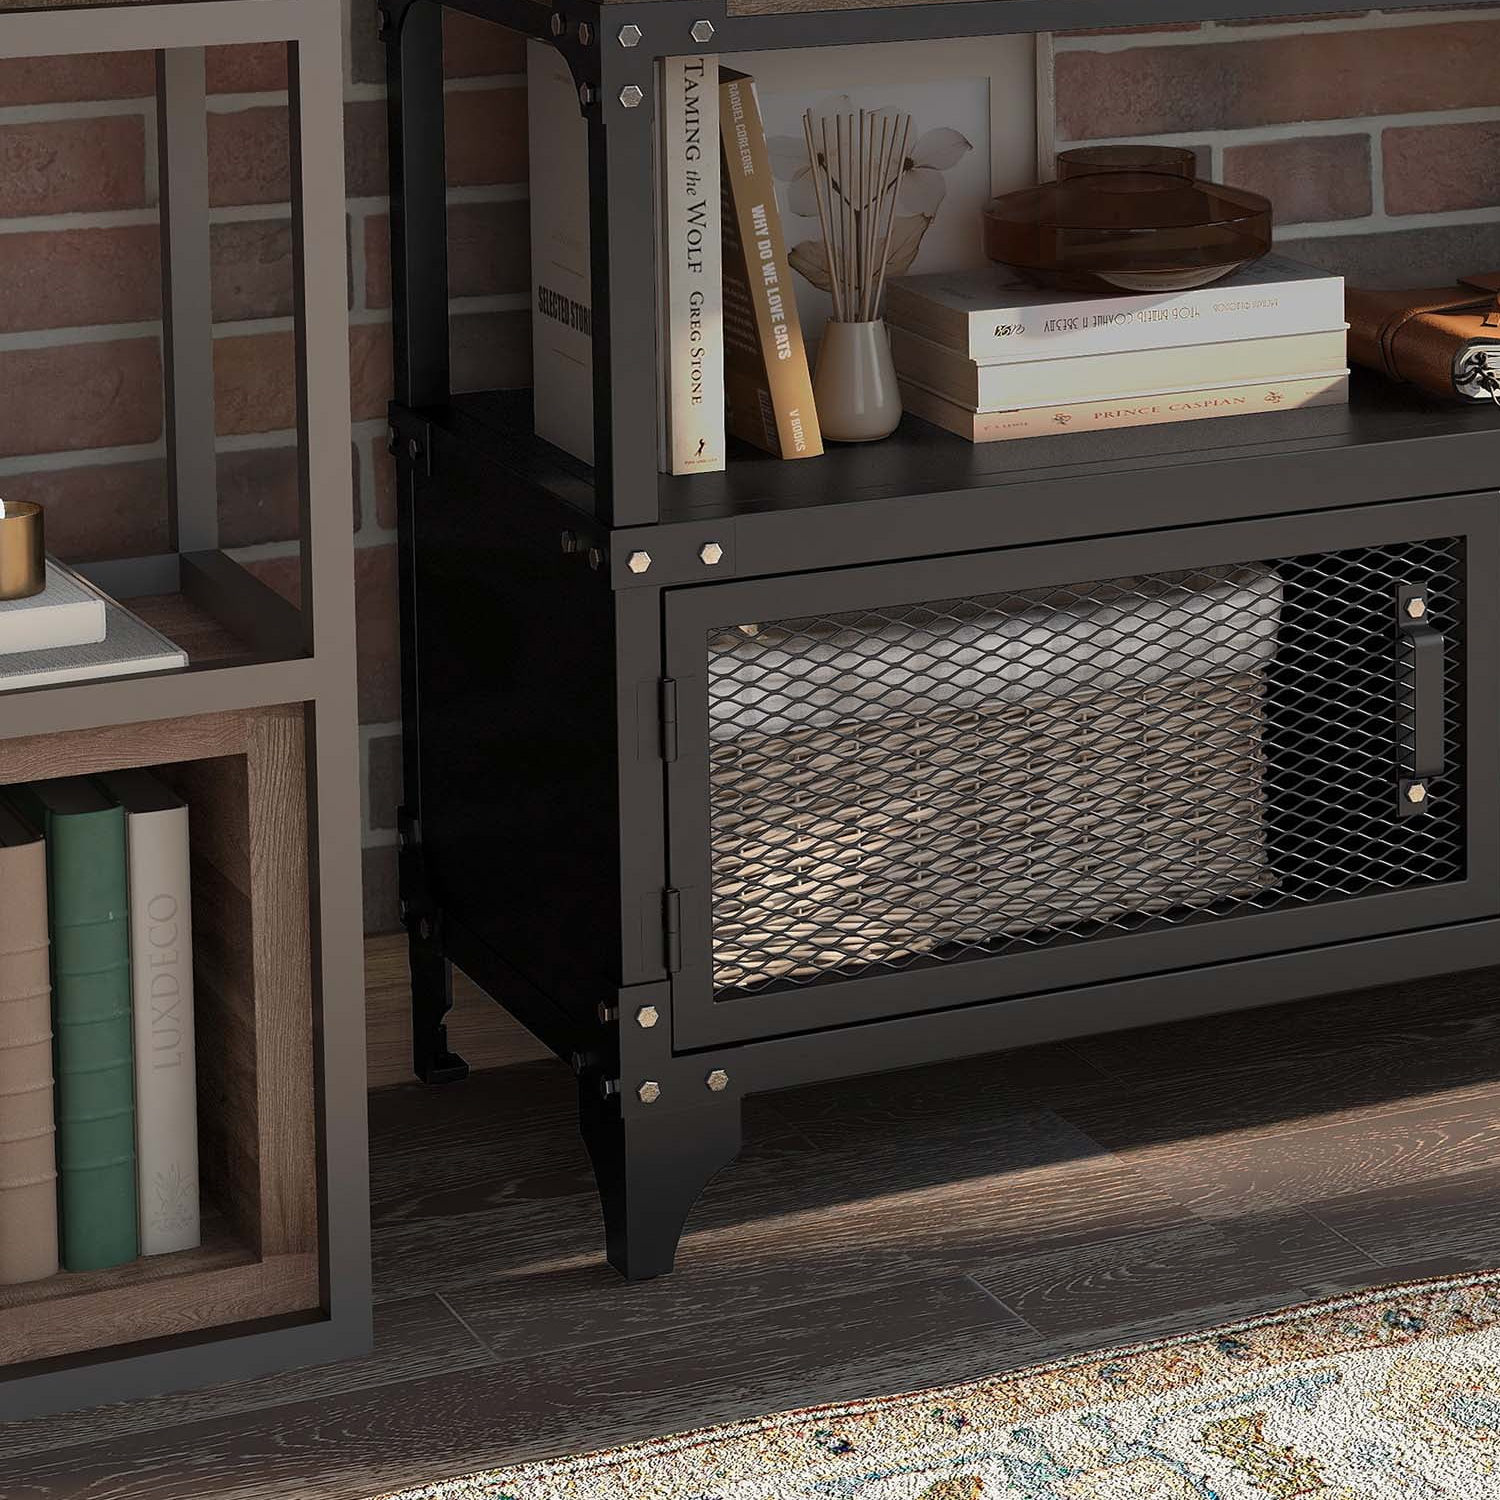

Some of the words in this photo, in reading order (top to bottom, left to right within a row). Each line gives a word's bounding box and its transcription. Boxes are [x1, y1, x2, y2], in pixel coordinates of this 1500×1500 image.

[683, 58, 705, 163] TAMING
[728, 83, 744, 122] RAQUEL
[735, 123, 755, 177] CORLEONE
[684, 169, 704, 197] the
[687, 201, 711, 274] WOLF
[751, 204, 770, 239] WHY
[757, 240, 773, 261] DO
[762, 262, 779, 286] WE
[538, 285, 570, 326] SELECTED
[688, 290, 706, 344] GREG
[767, 288, 786, 323] LOVE
[1043, 315, 1079, 332] ЗВЕЗДУ
[773, 324, 792, 361] CATS
[690, 347, 706, 406] STONE
[789, 409, 799, 420] V
[1094, 404, 1161, 420] PRINCE
[1169, 396, 1247, 412] CASPIAN
[791, 420, 807, 453] BOOKS
[146, 893, 181, 1071] LUXDECO
